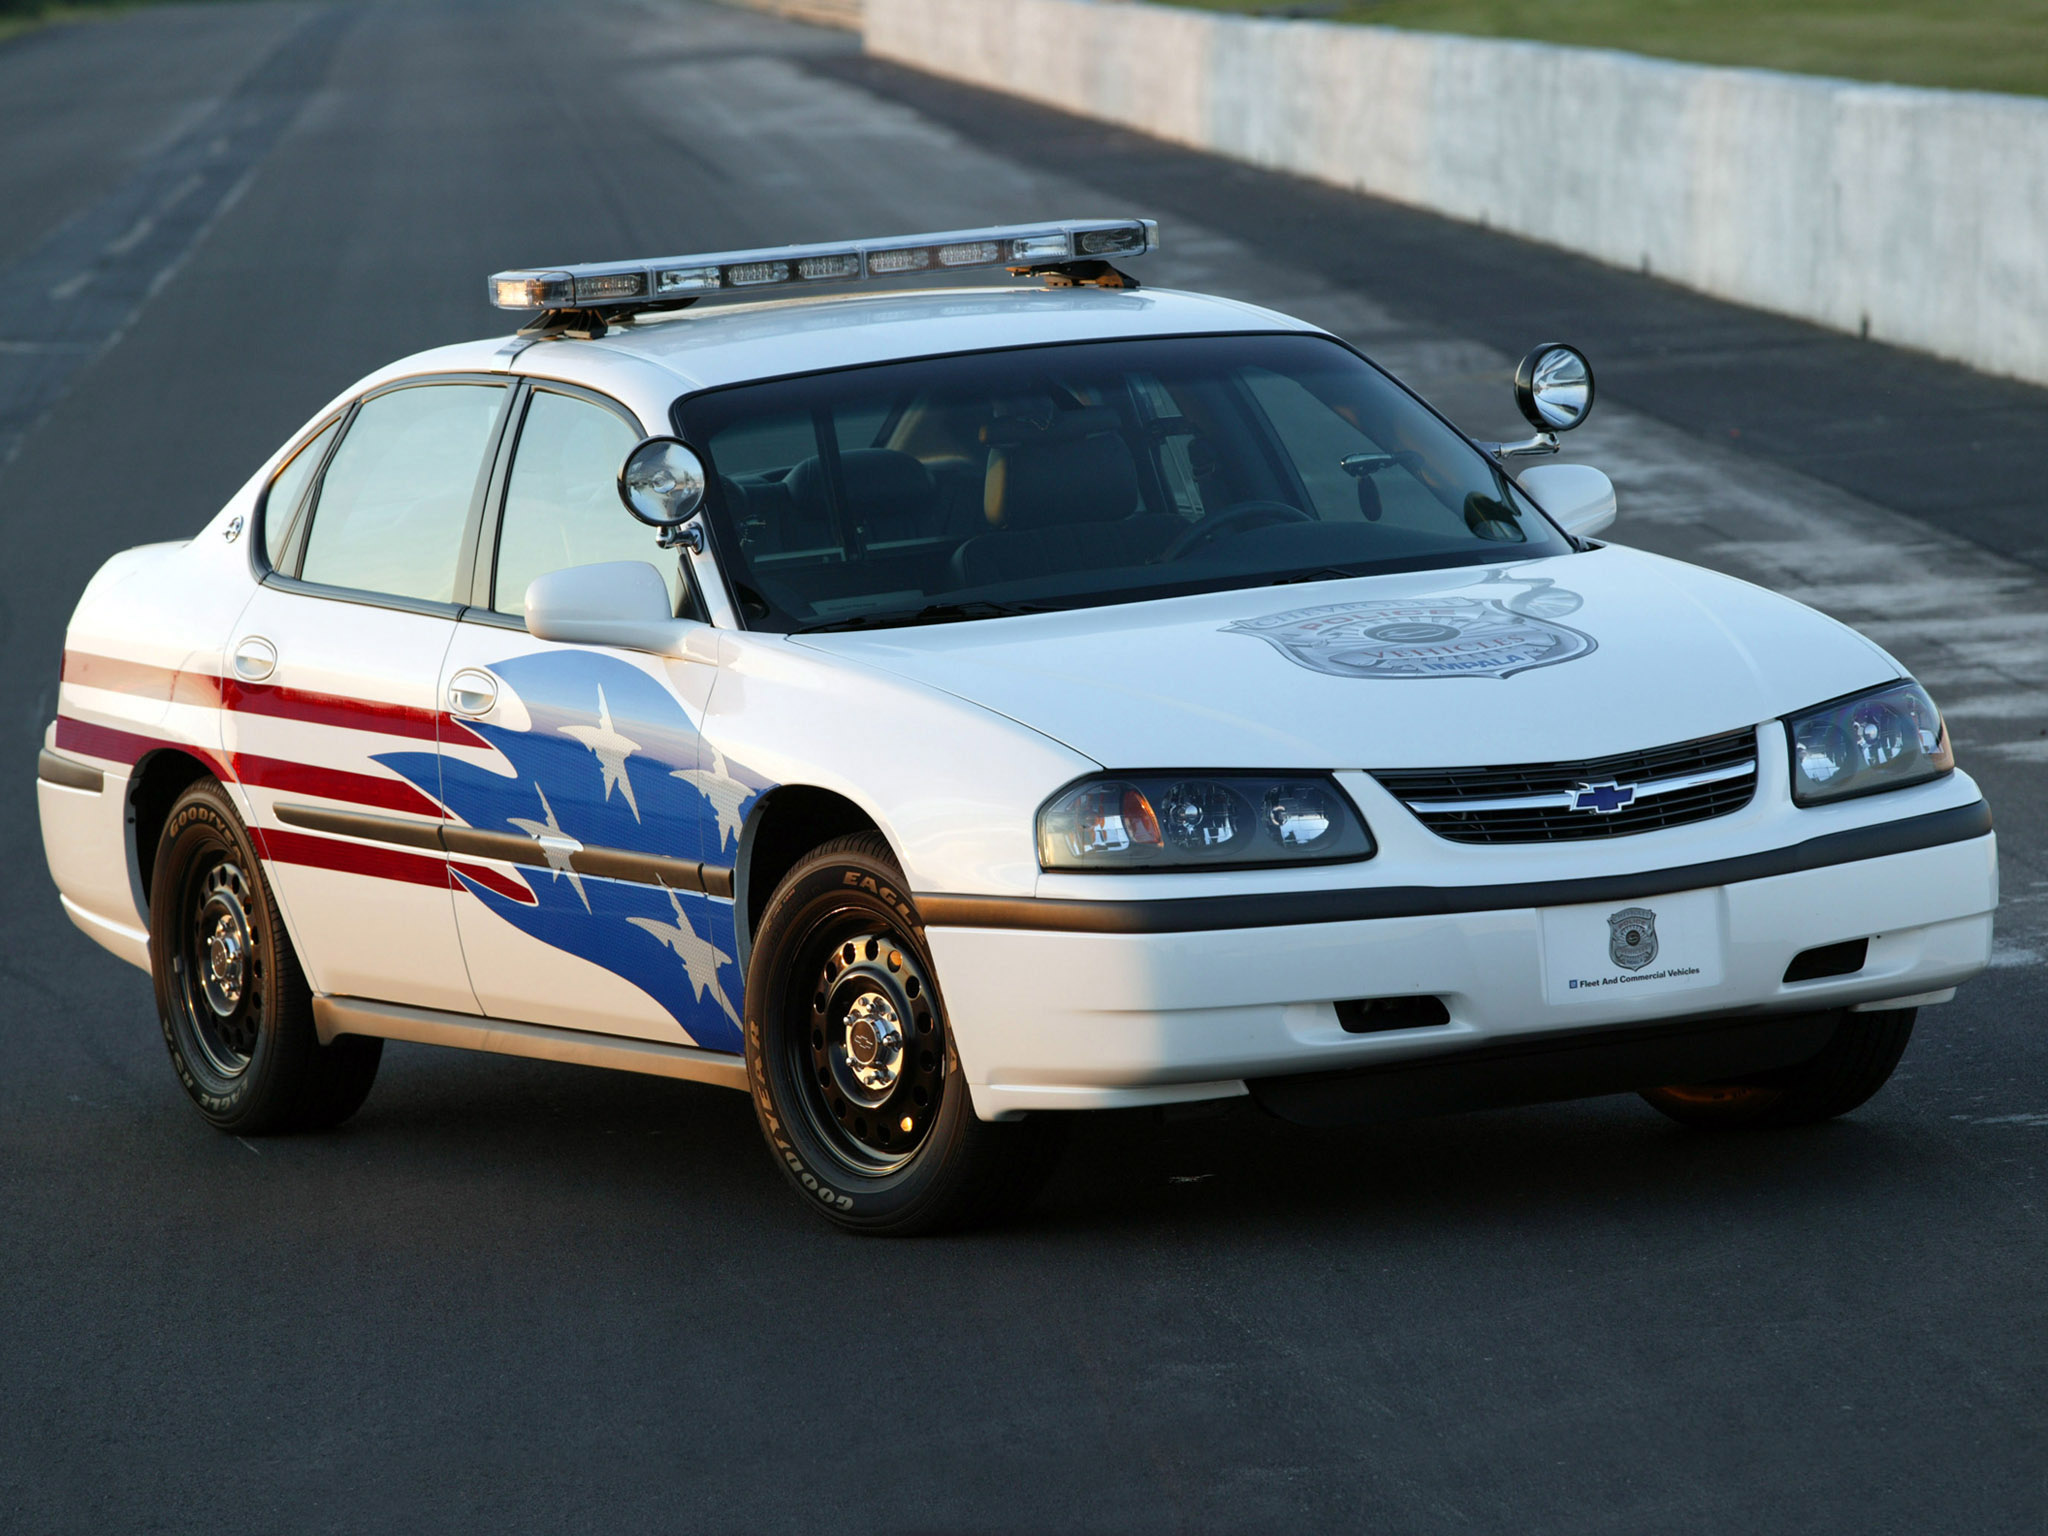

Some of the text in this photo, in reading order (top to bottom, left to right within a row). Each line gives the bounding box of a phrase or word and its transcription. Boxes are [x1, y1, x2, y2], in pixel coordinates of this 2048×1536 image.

[1299, 608, 1457, 632] POLICE
[1361, 632, 1526, 660] VEHICLES
[1425, 653, 1528, 673] IMPALA
[842, 871, 926, 946] EAGLE
[1579, 967, 1700, 988] Fleet And Commercial Vehicles
[749, 1019, 854, 1211] GOODYEAR
